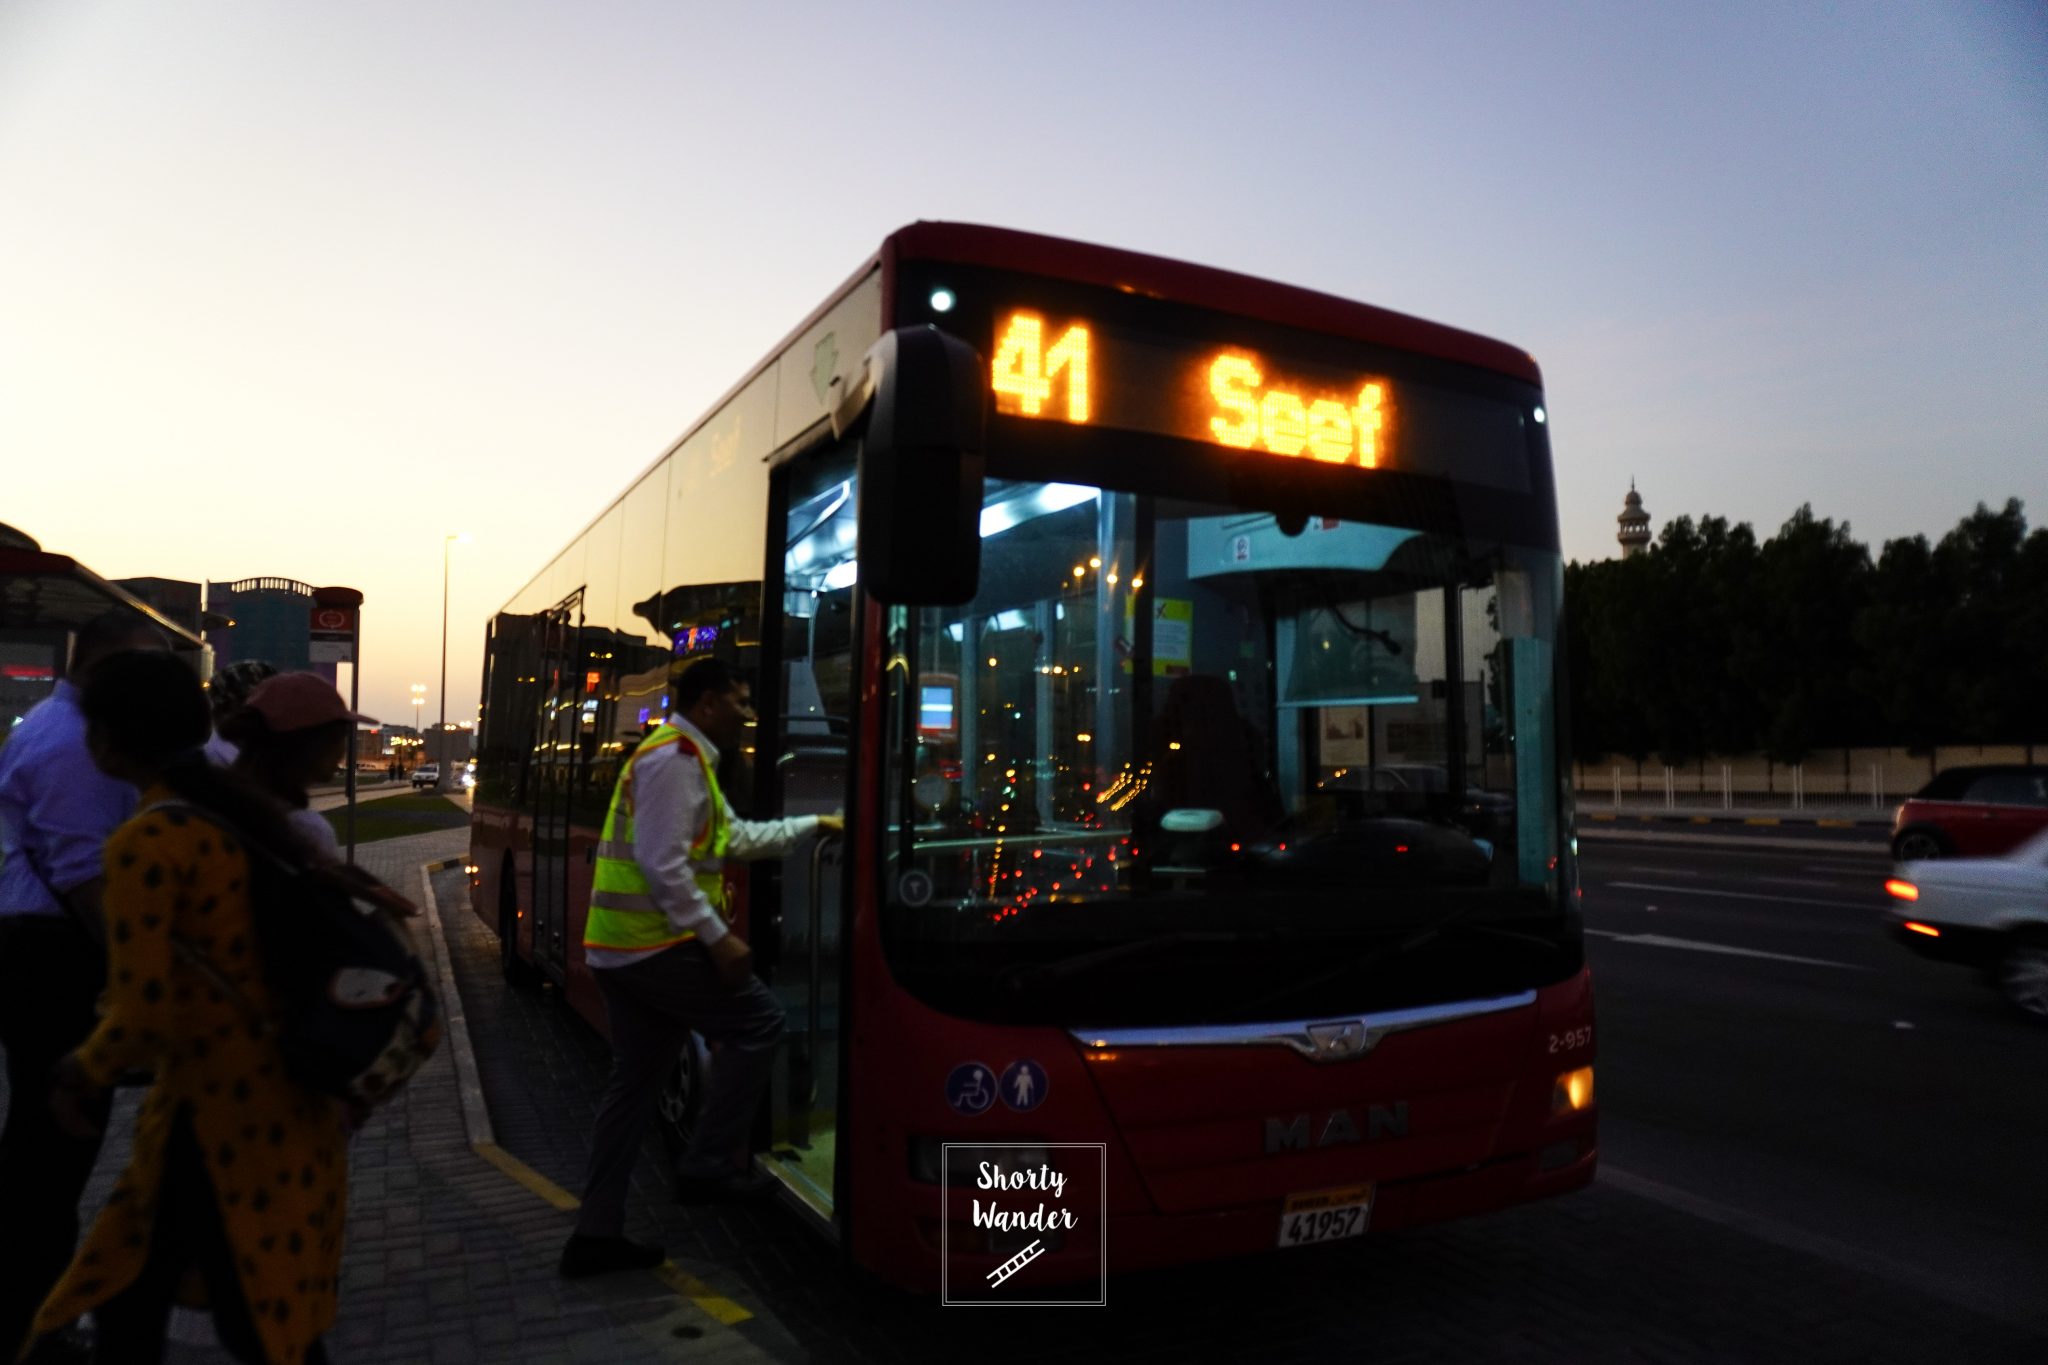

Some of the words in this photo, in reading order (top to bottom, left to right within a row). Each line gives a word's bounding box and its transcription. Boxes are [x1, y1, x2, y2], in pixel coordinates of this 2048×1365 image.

[992, 313, 1089, 423] 41
[1210, 353, 1382, 469] Seef
[1548, 1025, 1592, 1054] 2-957
[1264, 1100, 1409, 1154] MAN
[1287, 1206, 1362, 1243] 41957
